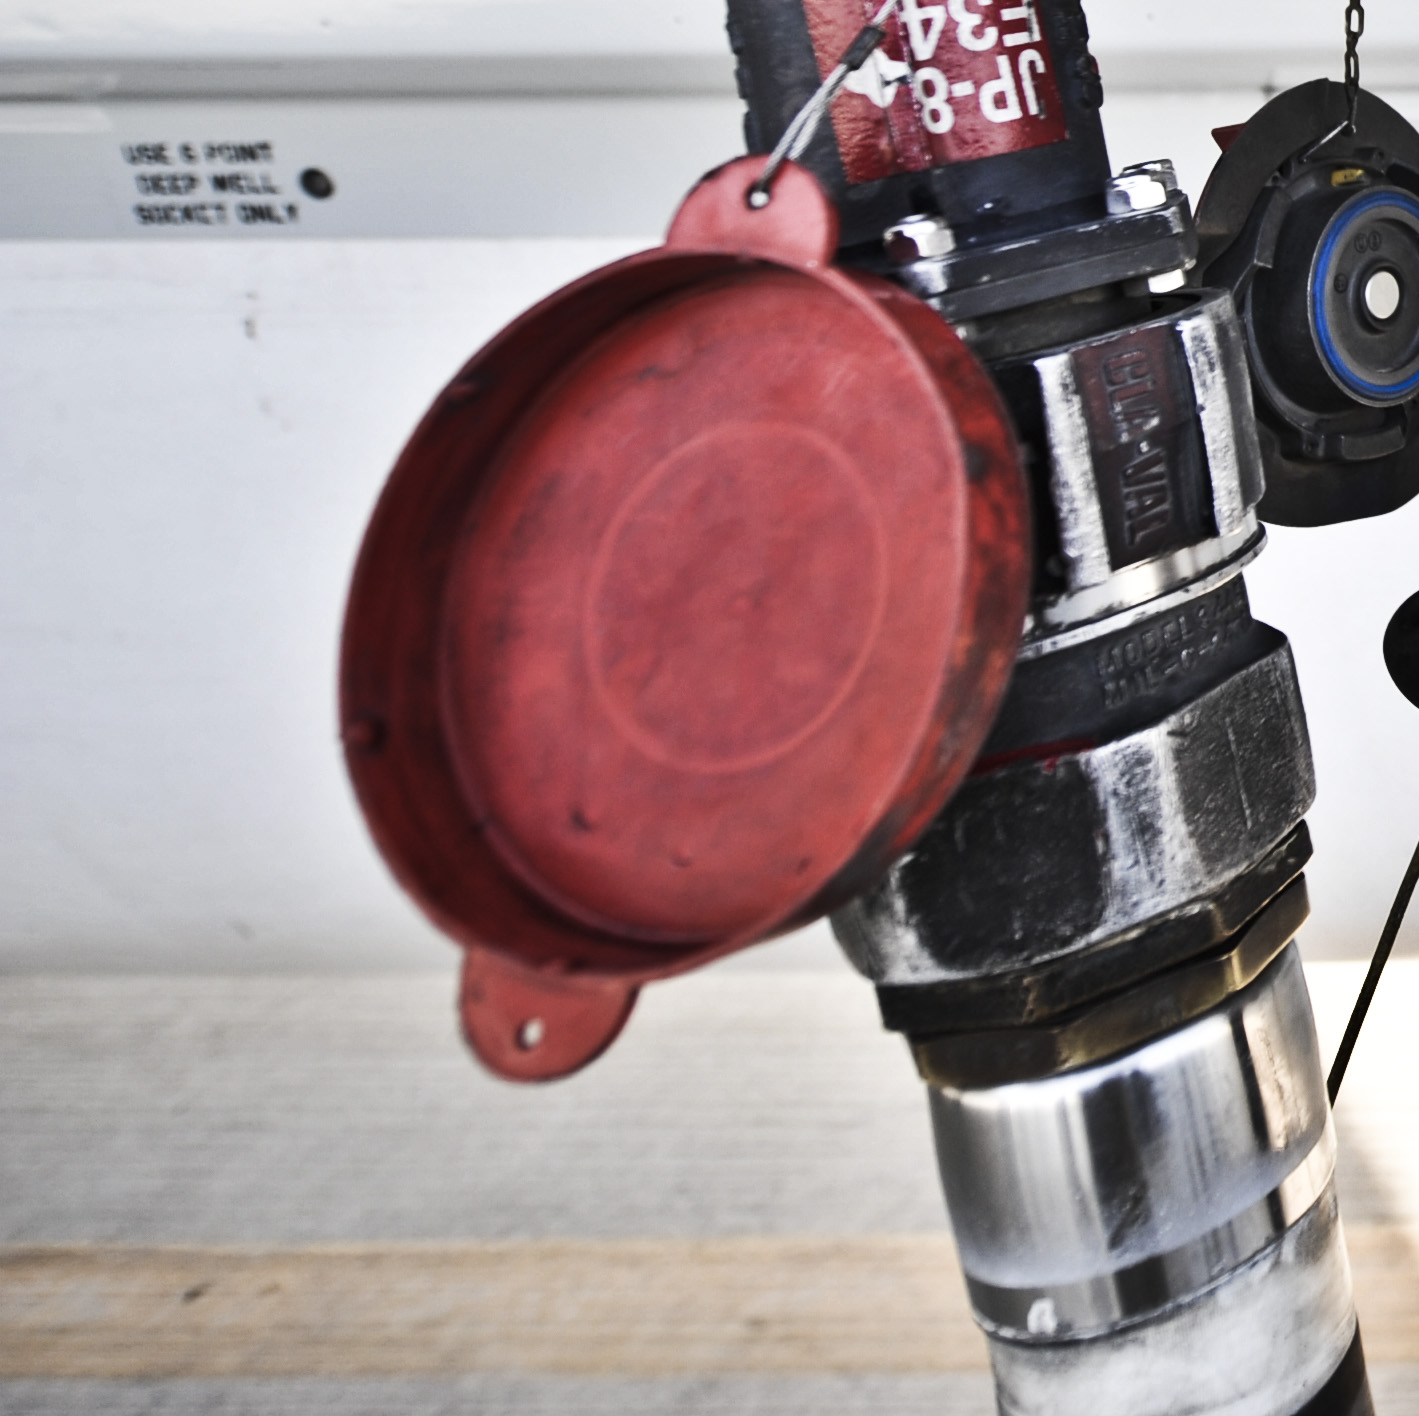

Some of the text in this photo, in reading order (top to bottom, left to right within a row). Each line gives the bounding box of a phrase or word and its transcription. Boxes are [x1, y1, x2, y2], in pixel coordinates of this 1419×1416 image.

[912, 49, 1045, 134] JP-8
[122, 143, 170, 164] USE
[203, 142, 272, 163] POINT
